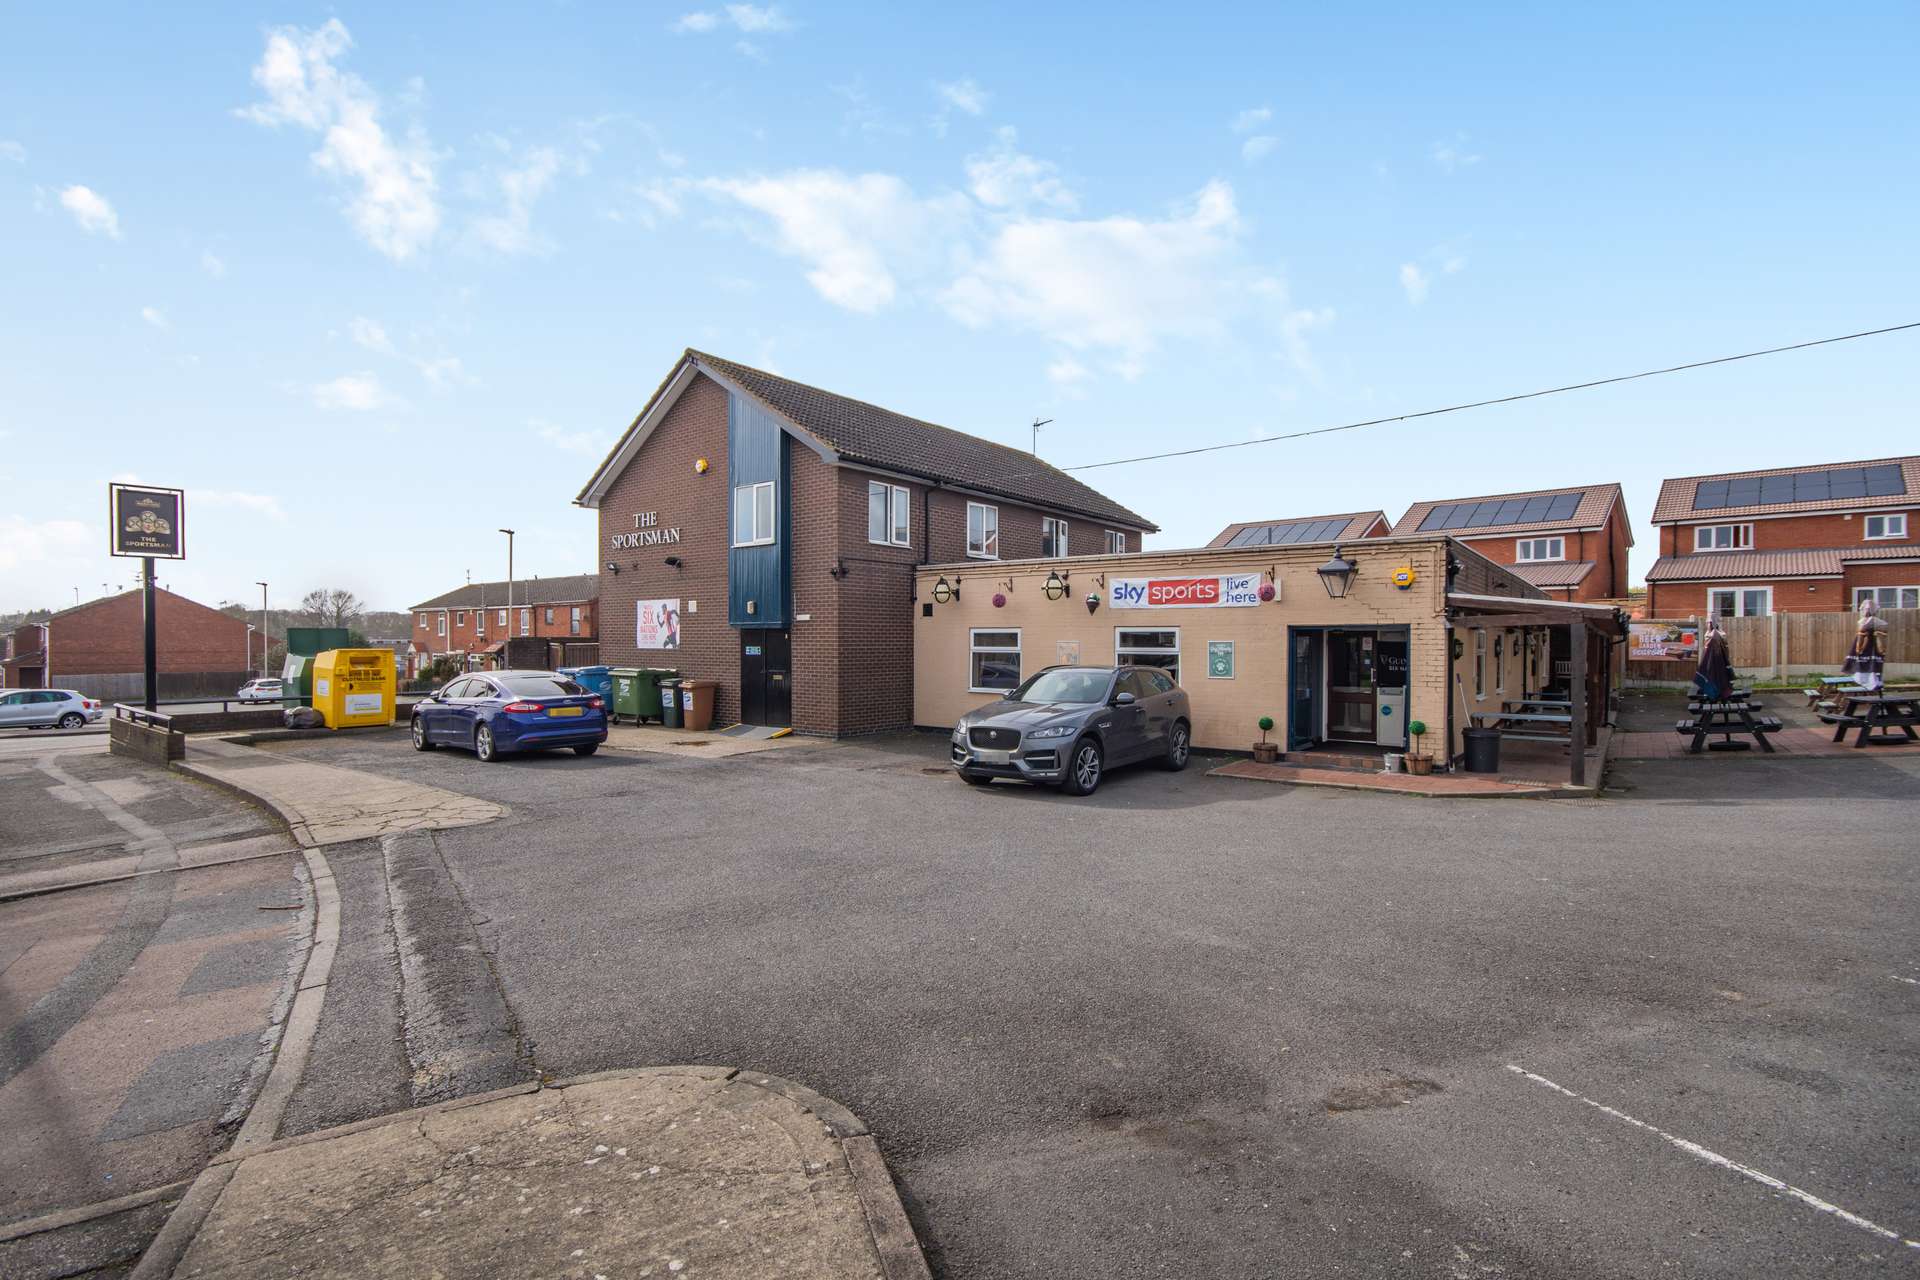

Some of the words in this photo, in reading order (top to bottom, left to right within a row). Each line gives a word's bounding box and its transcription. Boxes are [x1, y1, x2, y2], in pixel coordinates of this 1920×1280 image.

[632, 511, 657, 528] THE
[611, 527, 680, 549] SPORTSMAN
[1226, 577, 1249, 591] live
[1113, 582, 1145, 604] sky
[1151, 583, 1215, 603] sports
[1226, 591, 1257, 603] here
[643, 610, 654, 625] SIX
